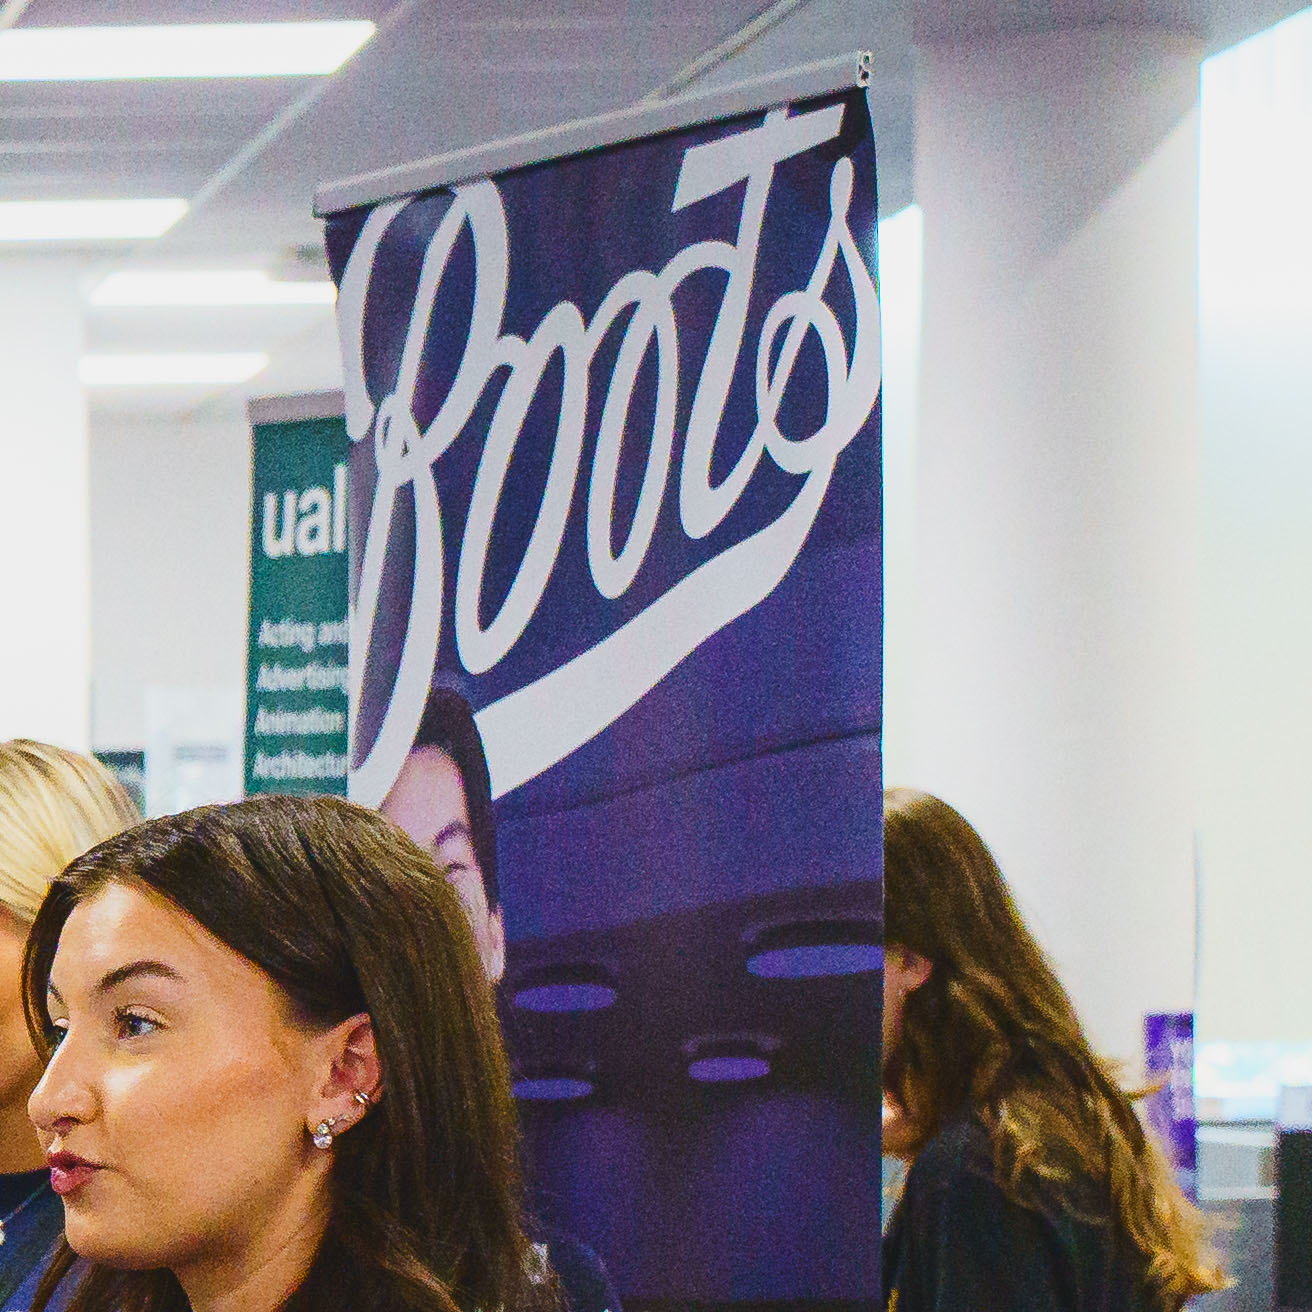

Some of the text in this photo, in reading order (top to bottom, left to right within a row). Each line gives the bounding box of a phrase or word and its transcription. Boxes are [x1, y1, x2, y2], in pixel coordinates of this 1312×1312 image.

[336, 103, 882, 800] Boots
[262, 461, 349, 559] ual
[258, 620, 314, 652] Acting
